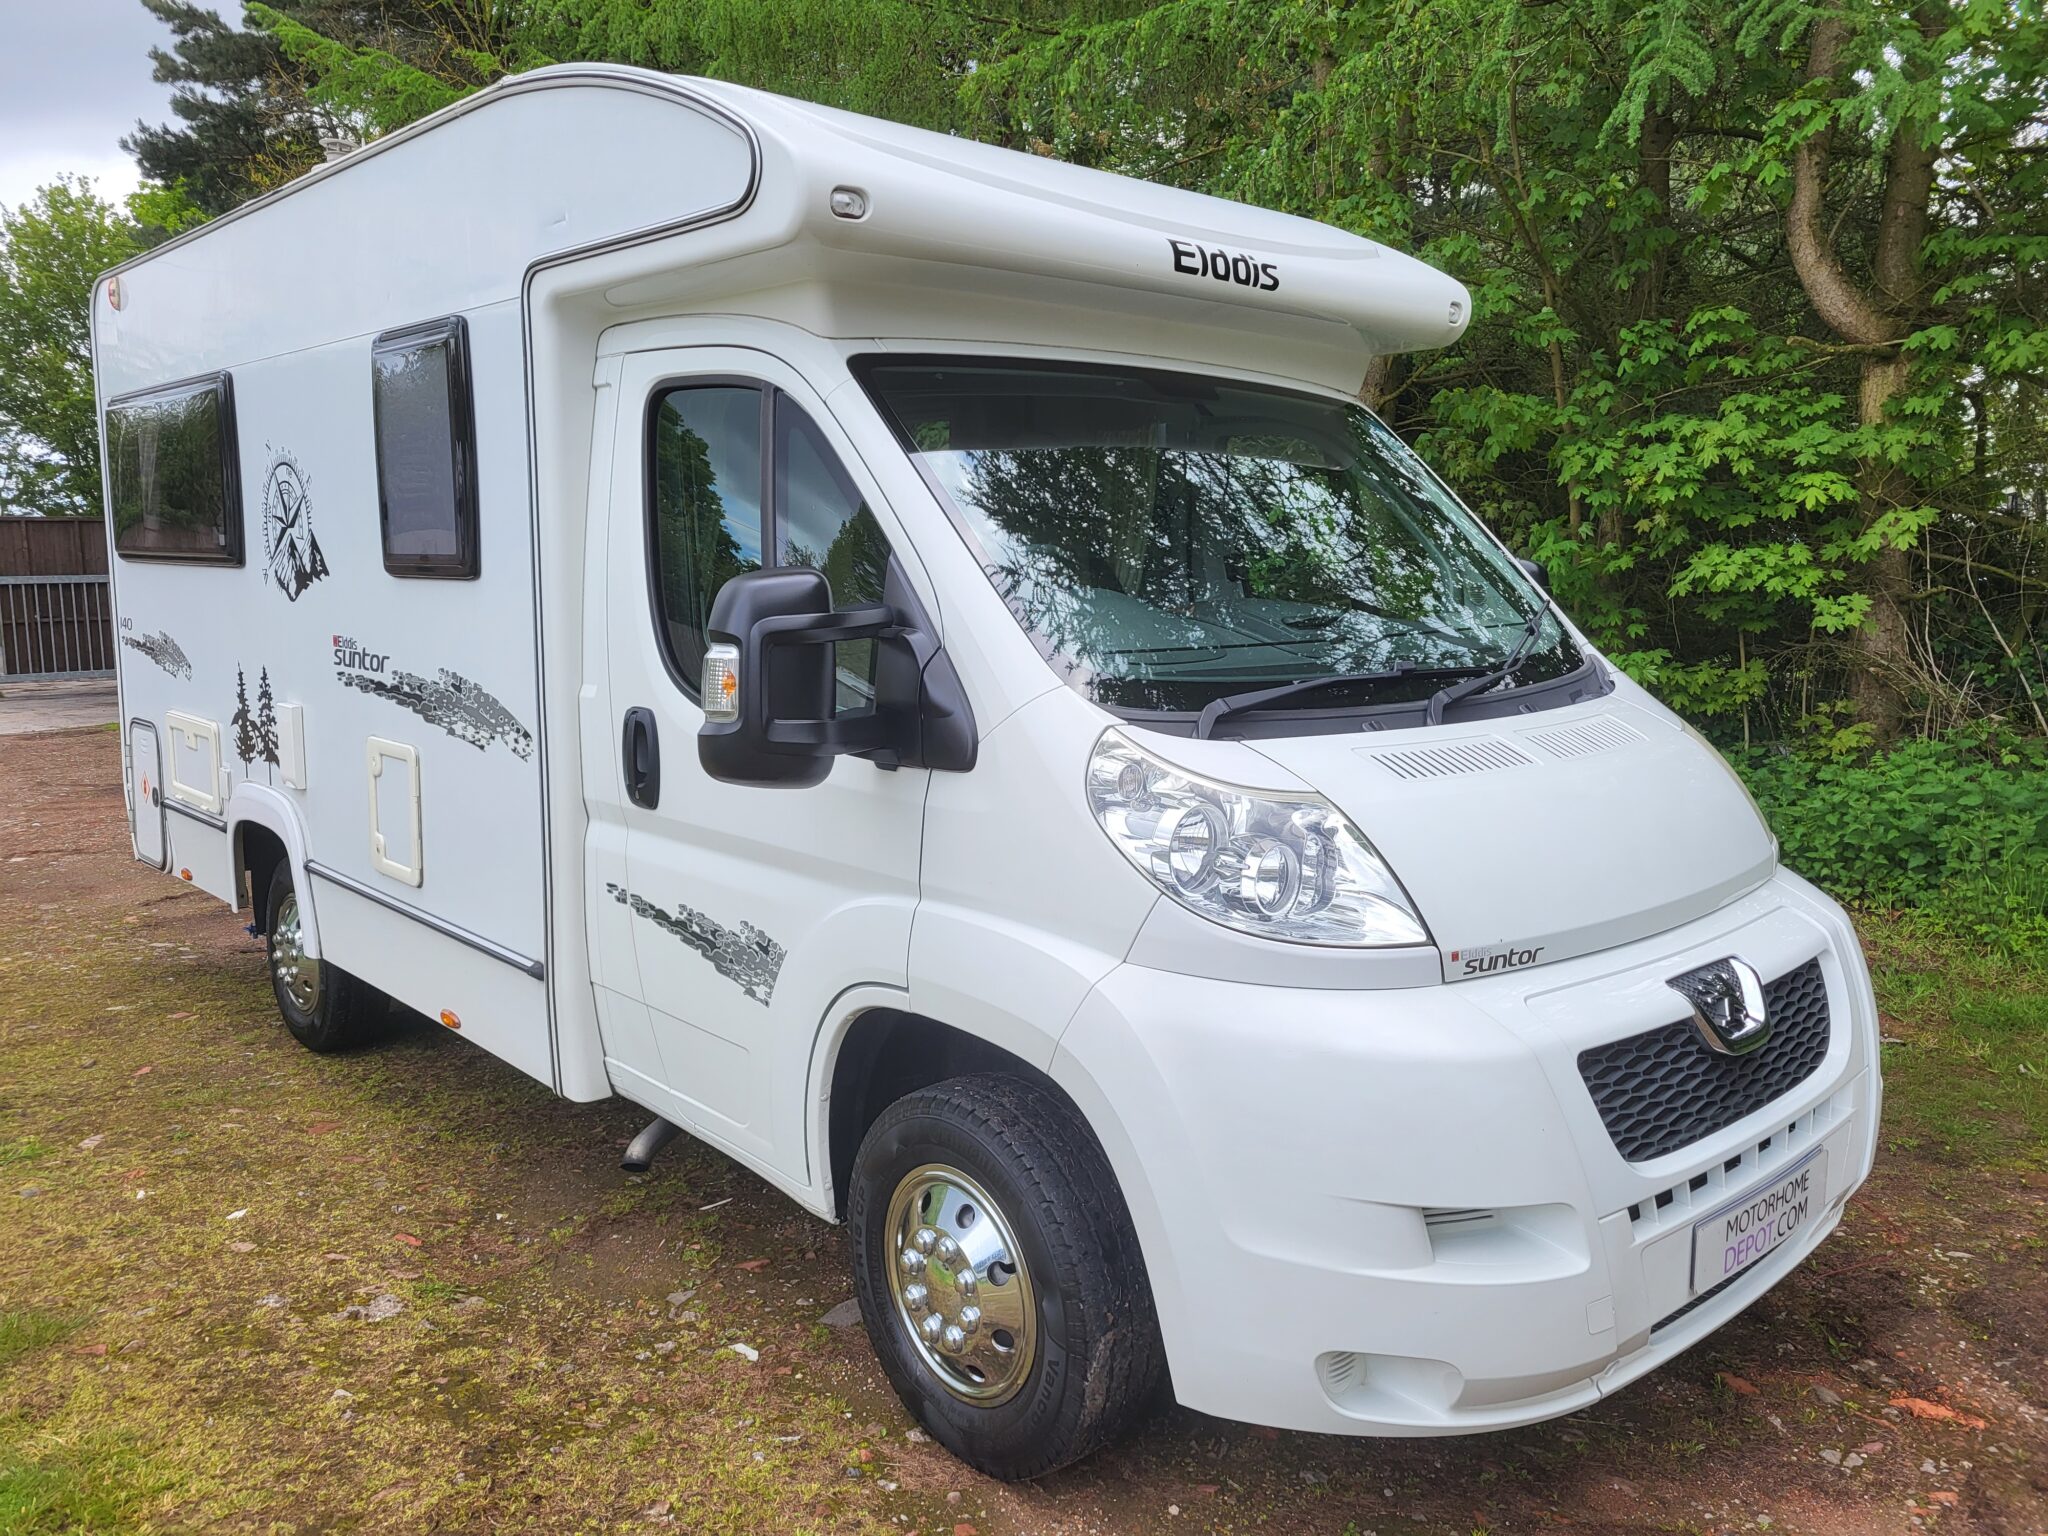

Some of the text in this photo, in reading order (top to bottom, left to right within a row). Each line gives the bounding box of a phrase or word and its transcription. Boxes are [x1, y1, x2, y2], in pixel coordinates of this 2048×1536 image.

[1166, 238, 1280, 291] Elddis
[333, 647, 391, 674] suntor
[337, 635, 358, 650] Elddis
[1462, 947, 1545, 976] suntor
[1725, 1169, 1810, 1242] MOTORHOME
[1723, 1196, 1809, 1275] DEPOT.COM
